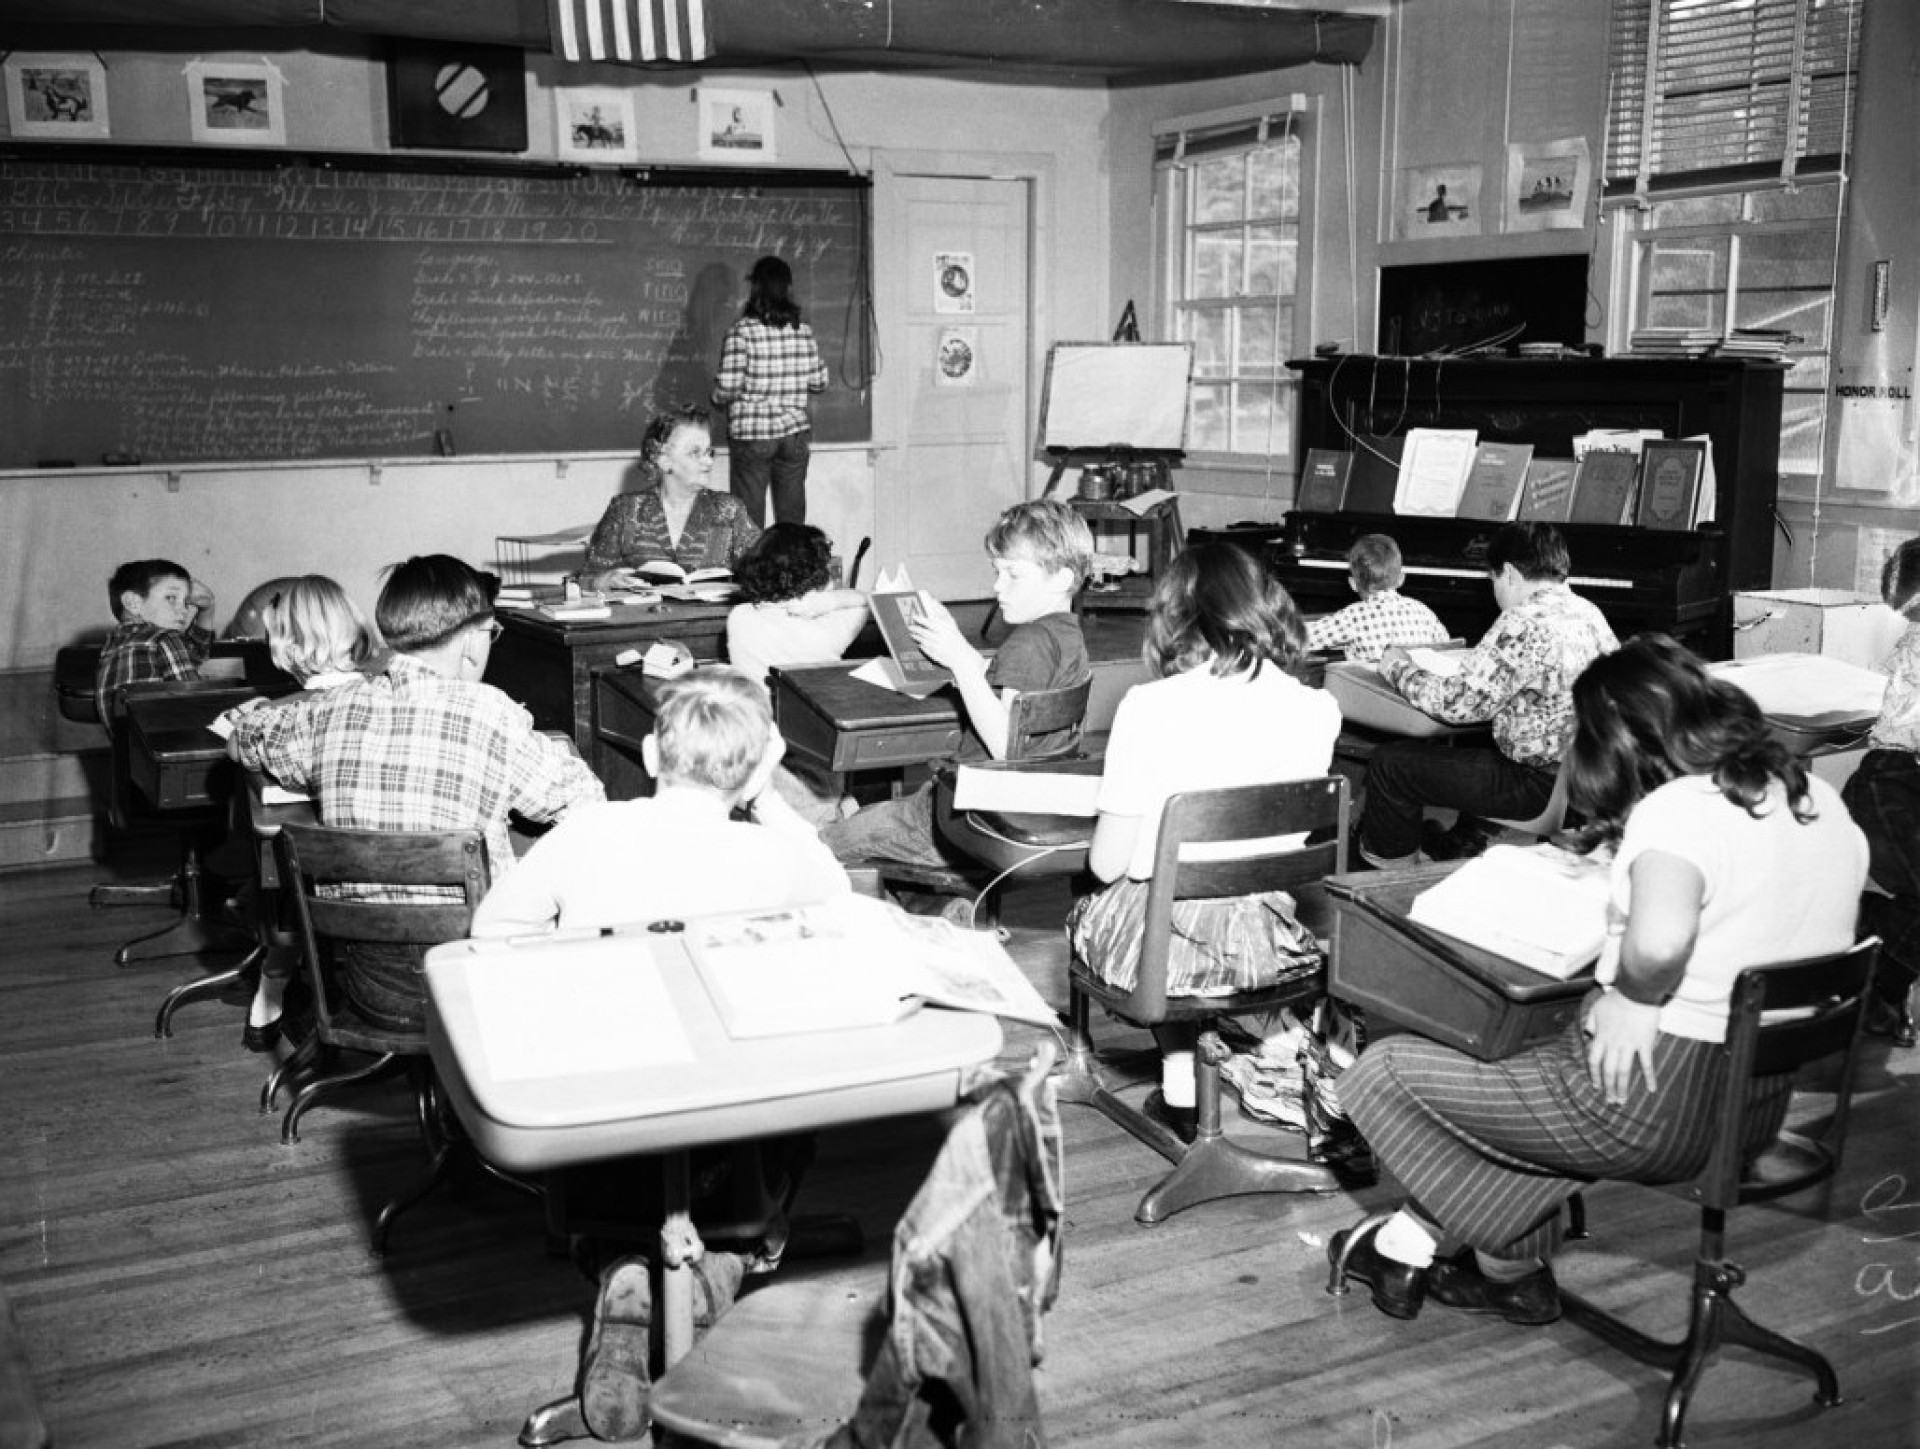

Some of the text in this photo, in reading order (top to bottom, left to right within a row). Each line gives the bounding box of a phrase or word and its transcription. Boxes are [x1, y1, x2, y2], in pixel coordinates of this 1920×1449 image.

[311, 217, 336, 239] 13
[343, 218, 369, 240] 14
[378, 217, 406, 240] 15
[416, 219, 441, 241] 16
[447, 219, 471, 241] 17
[481, 219, 506, 241] 18
[522, 221, 548, 241] 19
[643, 282, 689, 307] ring
[1836, 385, 1912, 399] HONOR ROLL
